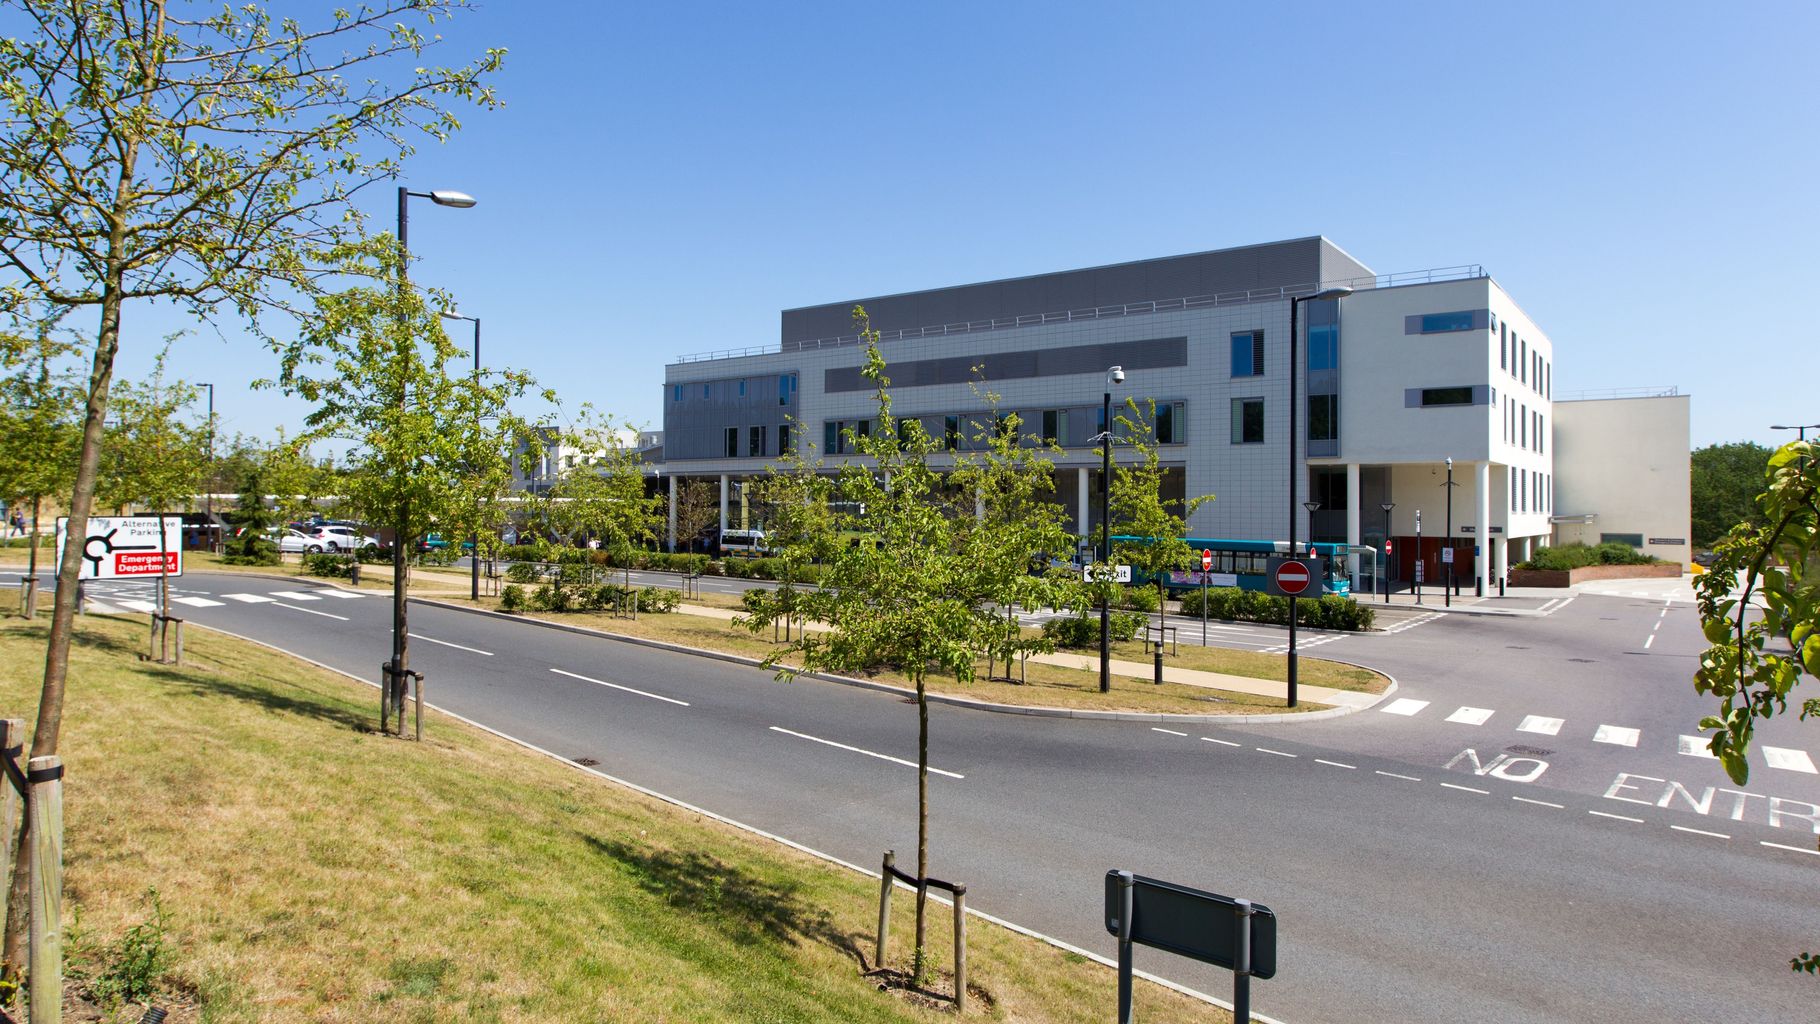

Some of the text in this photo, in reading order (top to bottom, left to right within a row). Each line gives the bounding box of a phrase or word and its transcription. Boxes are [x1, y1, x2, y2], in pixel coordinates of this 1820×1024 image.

[122, 520, 176, 528] Alternave
[121, 554, 174, 564] Emergeny
[1440, 748, 1550, 783] NO
